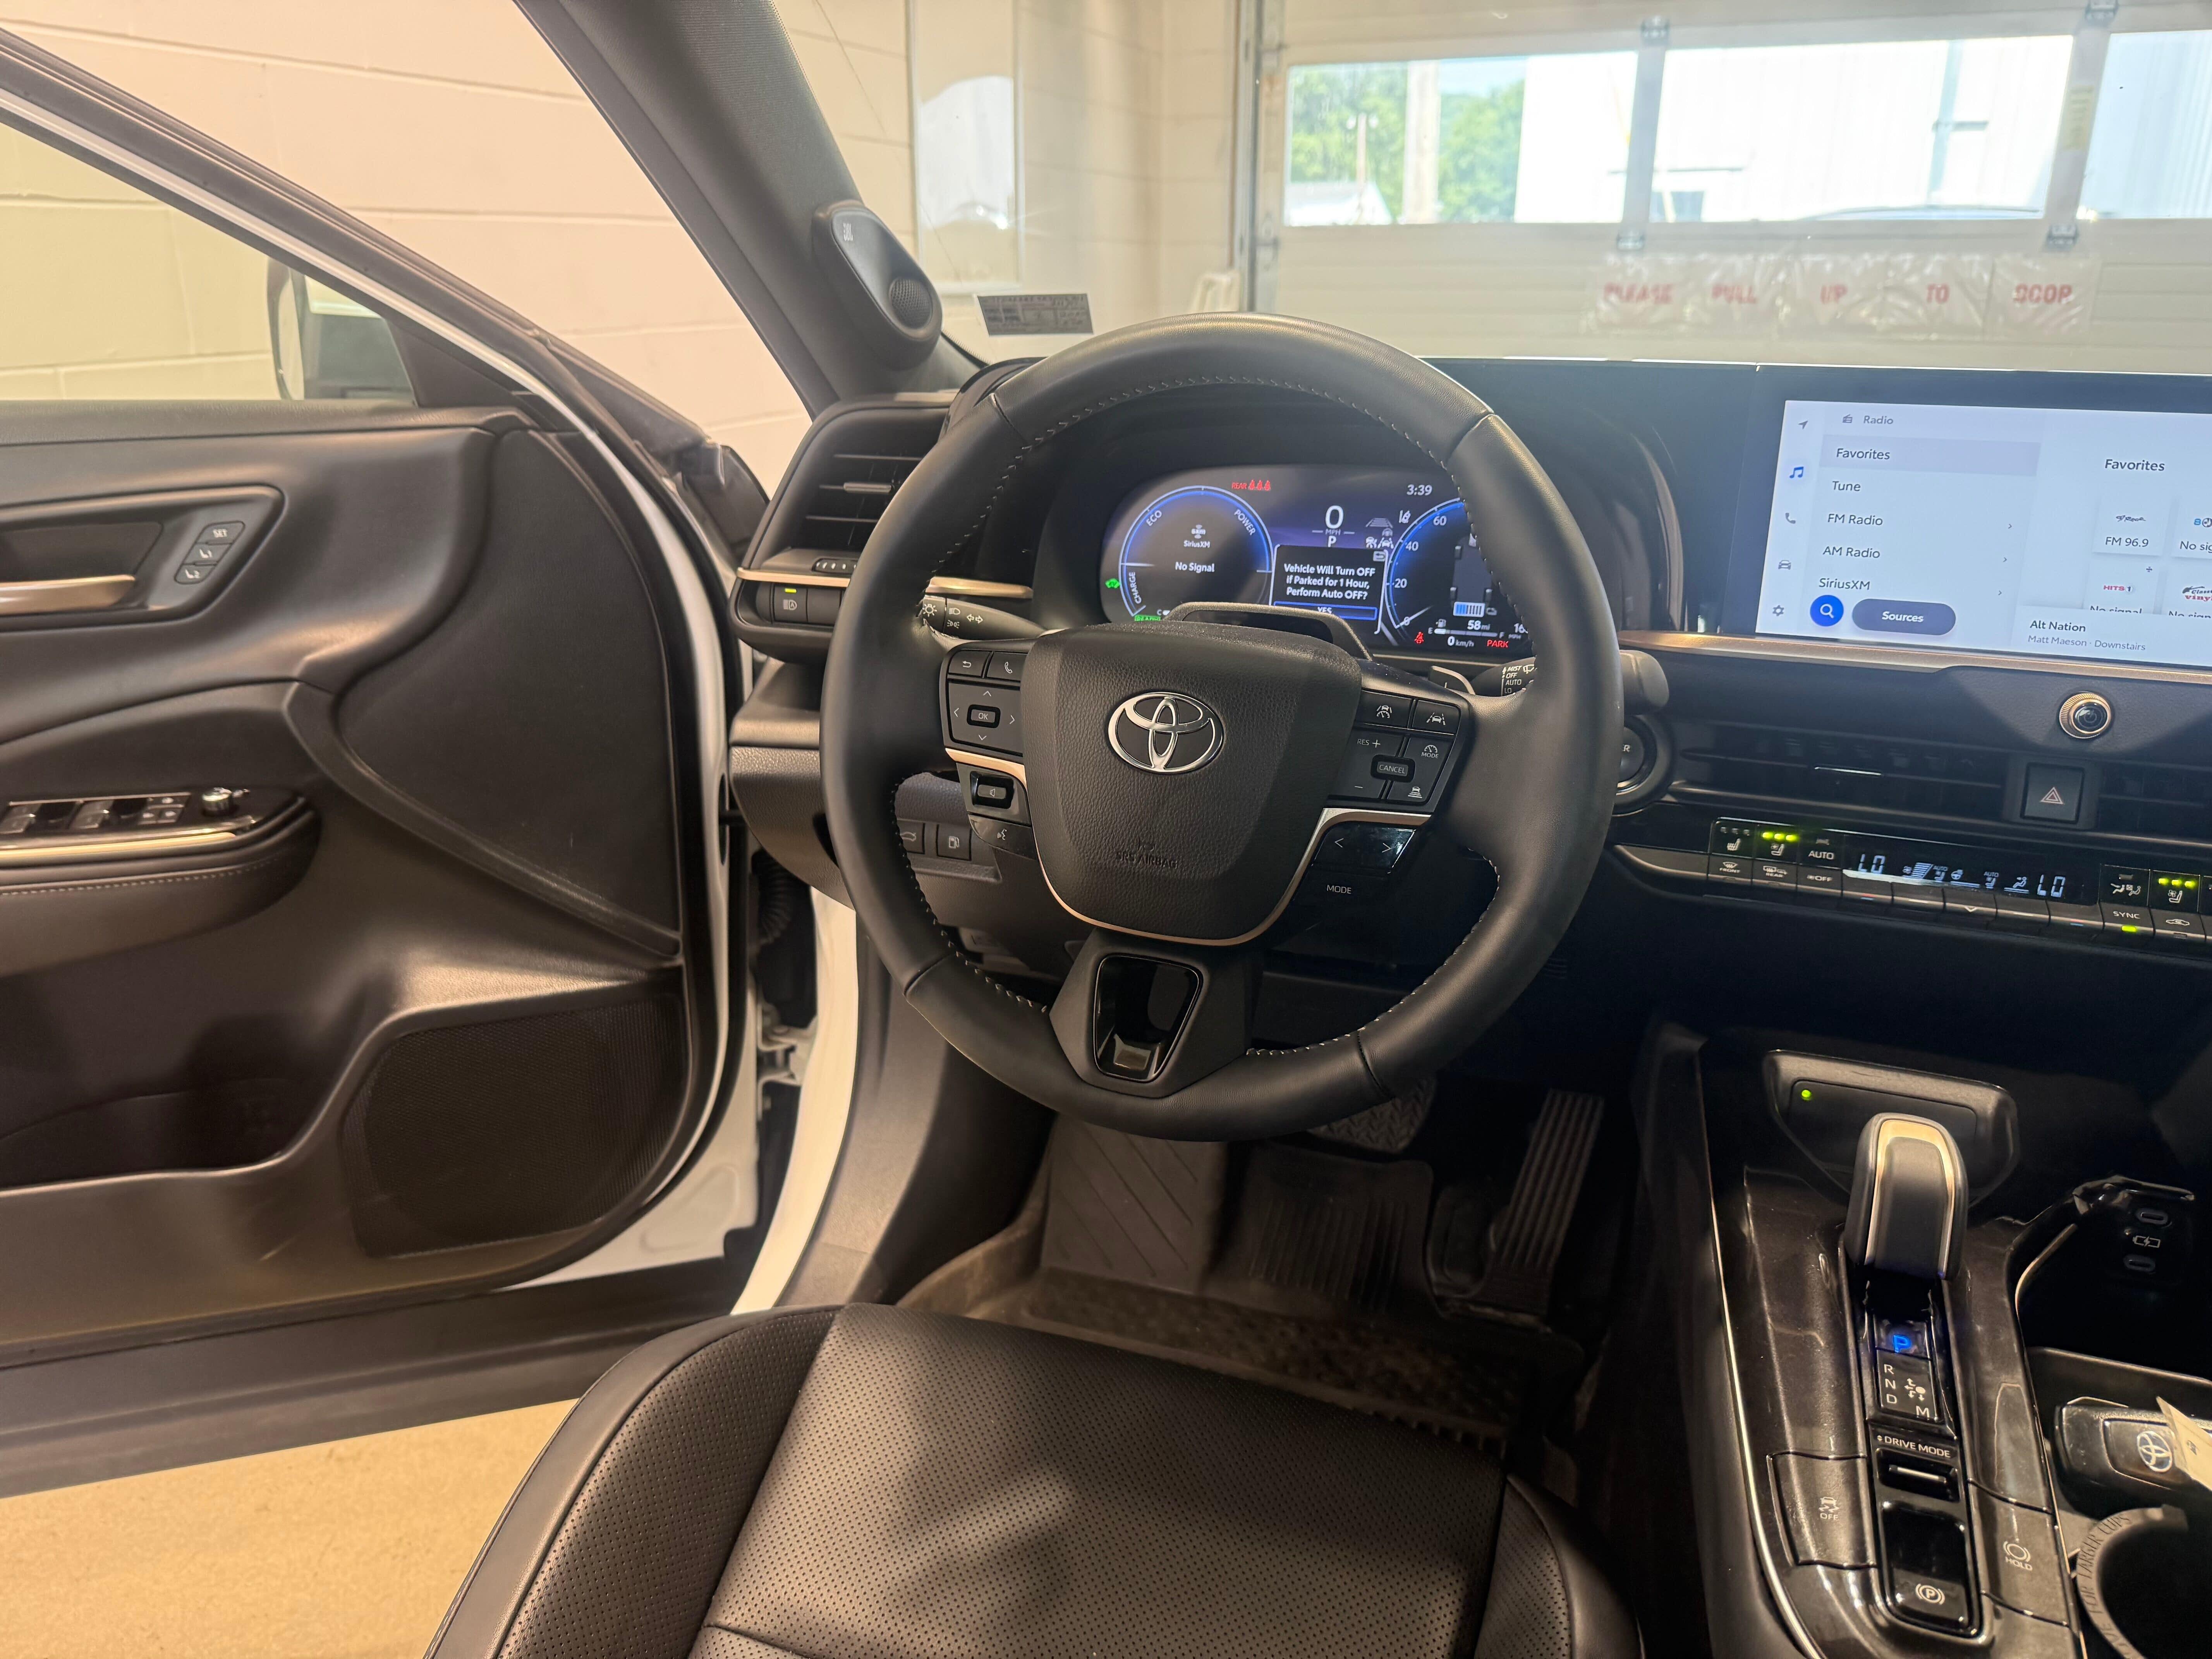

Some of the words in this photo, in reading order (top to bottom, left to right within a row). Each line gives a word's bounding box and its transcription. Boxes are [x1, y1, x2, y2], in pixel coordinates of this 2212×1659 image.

[1820, 283, 1847, 304] UP
[1926, 283, 1950, 304] TO
[1863, 415, 1894, 425] Radio
[1836, 448, 1890, 460] Favorites
[2105, 459, 2165, 471] Favorites
[1407, 484, 1432, 496] 3:39
[1832, 481, 1861, 492] Tune
[1146, 510, 1162, 527] ECO
[1234, 509, 1256, 536] POWER
[1325, 505, 1344, 529] 0
[1433, 515, 1447, 526] 60
[1827, 513, 1845, 524] FM
[1848, 514, 1883, 526] Radio
[1328, 536, 1337, 548] P
[1406, 541, 1419, 551] 40
[2106, 537, 2122, 546] FM
[2125, 538, 2149, 547] 96.9
[2180, 541, 2197, 550] No
[1822, 546, 1842, 556] AM
[1846, 548, 1881, 559] Radio
[1175, 562, 1187, 571] No
[1189, 563, 1215, 574] Signal
[1284, 563, 1315, 573] Vehicle
[1317, 565, 1333, 575] Will
[1335, 566, 1355, 576] Turn
[1357, 567, 1376, 577] OFF
[1128, 572, 1142, 604] CHARGE
[1294, 575, 1324, 586] Parked
[1325, 577, 1338, 586] for
[1340, 578, 1344, 587] 1
[1345, 579, 1370, 589] Hour,
[1395, 578, 1407, 588] 20
[1819, 577, 1870, 591] SiriusXM
[1286, 587, 1320, 597] Perform
[1321, 589, 1343, 599] Auto
[1345, 590, 1368, 600] OFF?
[1882, 611, 1924, 623] Sources
[1467, 620, 1481, 630] 58
[2030, 620, 2046, 629] Alt
[2049, 622, 2086, 632] Nation
[1447, 636, 1455, 646] 0
[1455, 639, 1474, 647] km/h
[1487, 639, 1509, 648] PARK
[2028, 635, 2049, 644] Matt
[2051, 636, 2087, 647] Maeson
[2094, 640, 2146, 651] Downstairs
[1379, 764, 1405, 774] CANCEL
[1808, 850, 1834, 860] AUTO
[1327, 884, 1352, 894] MODE
[2113, 910, 2141, 919] SYNC
[1893, 1334, 1912, 1353] P
[1884, 1364, 1894, 1374] R
[1885, 1378, 1896, 1390] N
[1886, 1394, 1898, 1405] D
[1916, 1405, 1930, 1419] M
[1884, 1436, 1916, 1450] DRIVE
[1918, 1444, 1952, 1458] MODE
[1820, 1512, 1839, 1521] OFF
[2076, 1534, 2104, 1580] LARGER
[2097, 1516, 2131, 1535] CUPS
[2005, 1556, 2033, 1571] HOLD
